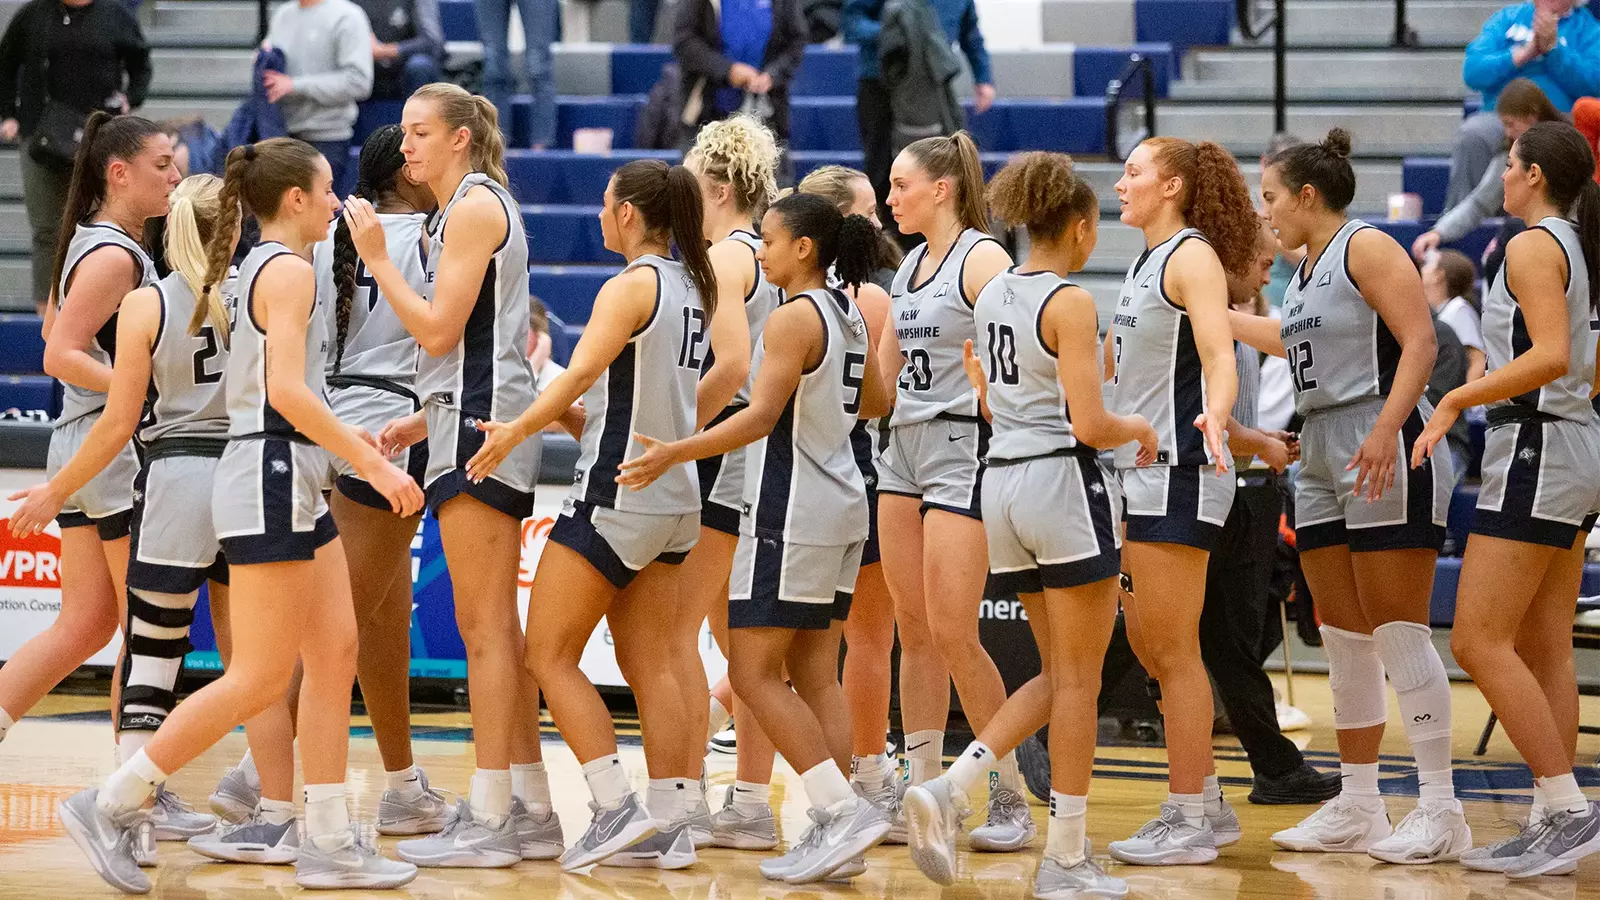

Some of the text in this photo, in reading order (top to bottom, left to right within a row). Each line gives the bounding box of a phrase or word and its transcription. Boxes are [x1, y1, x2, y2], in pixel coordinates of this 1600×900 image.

[678, 305, 706, 371] 12
[900, 309, 920, 320] NEW
[1288, 303, 1305, 318] NEW
[841, 350, 866, 416] 5
[987, 321, 1020, 386] 10
[1287, 340, 1319, 394] 42
